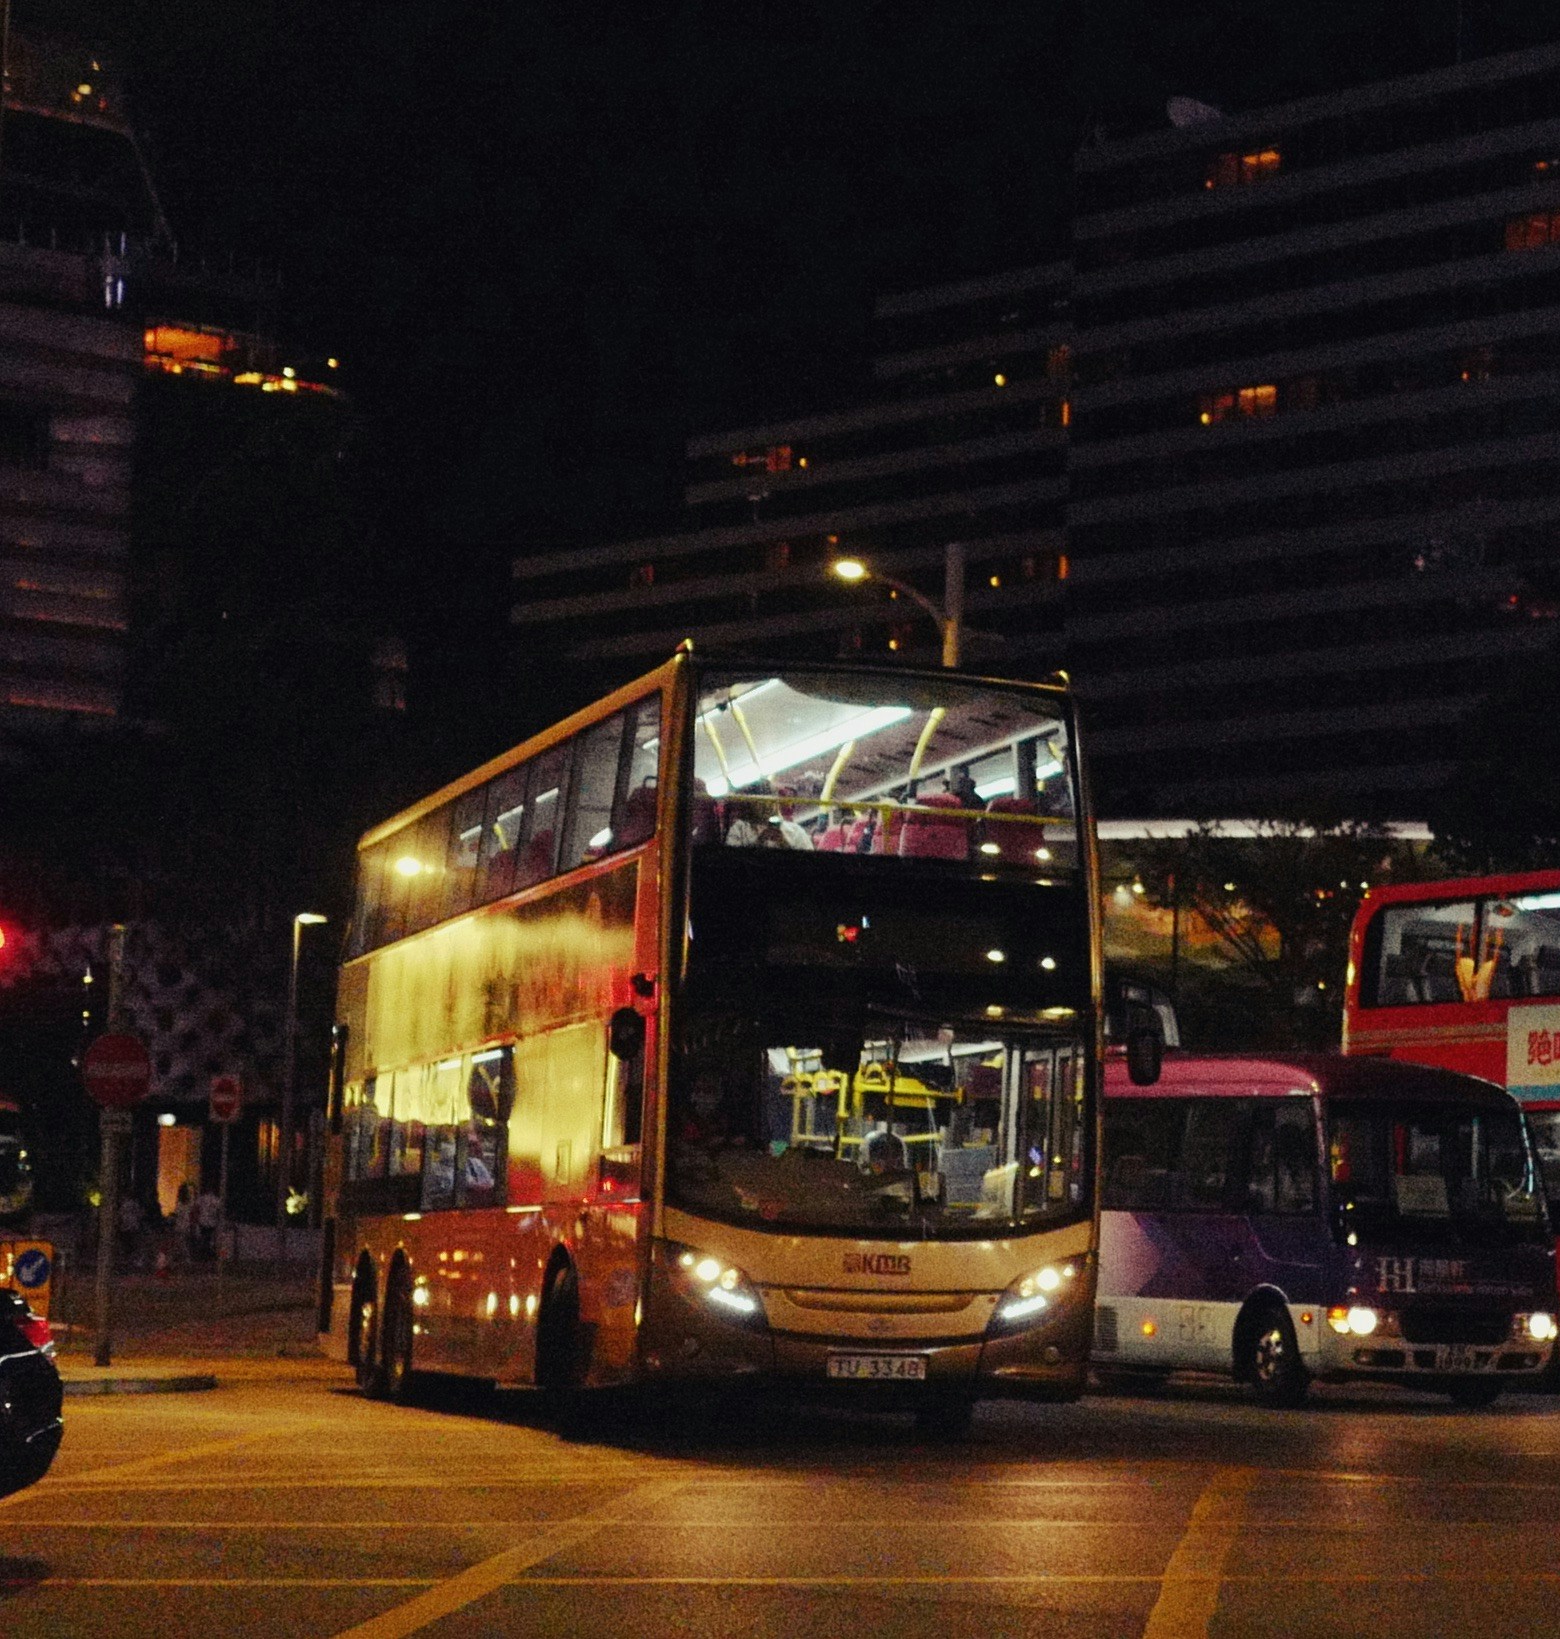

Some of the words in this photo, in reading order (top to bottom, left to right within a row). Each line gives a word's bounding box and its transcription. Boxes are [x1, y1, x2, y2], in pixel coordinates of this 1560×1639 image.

[862, 1253, 911, 1275] KMB
[835, 1359, 859, 1376] TU
[869, 1359, 920, 1377] 3348
